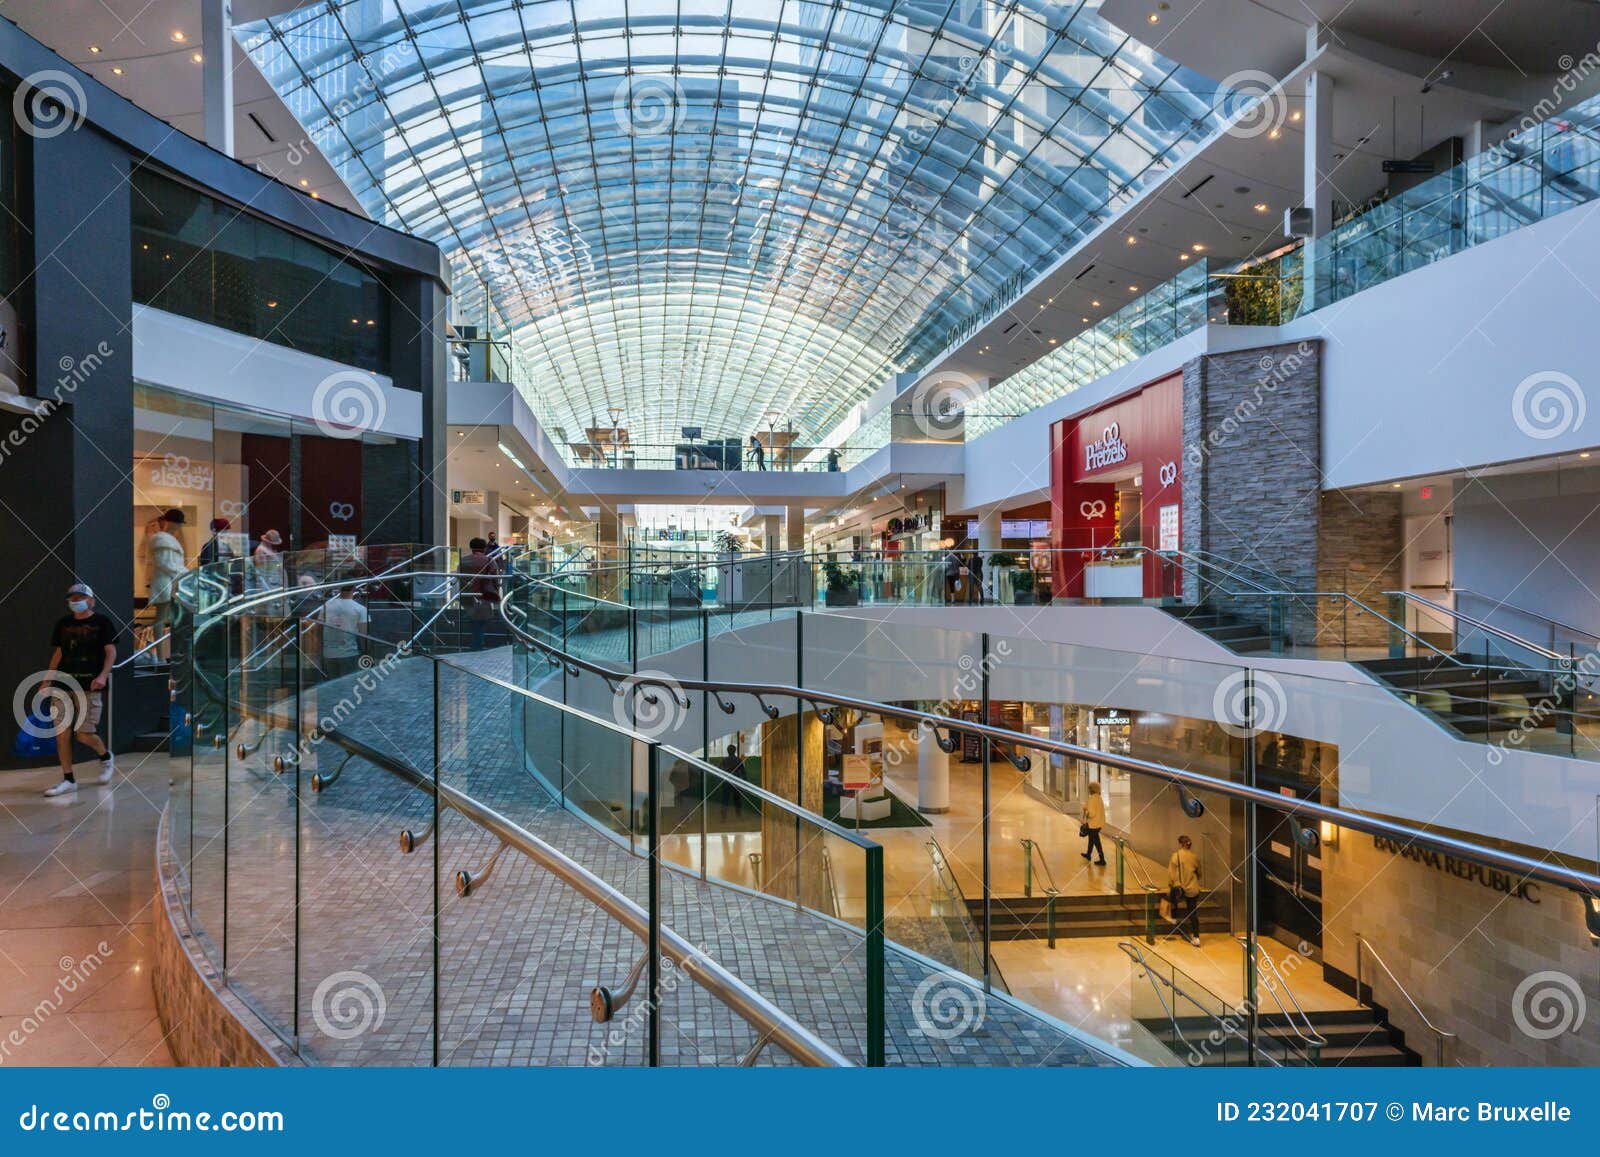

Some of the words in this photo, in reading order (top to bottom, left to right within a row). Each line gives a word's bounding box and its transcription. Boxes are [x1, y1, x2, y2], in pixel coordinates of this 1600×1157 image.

[1085, 438, 1128, 471] Pretzels
[1373, 834, 1443, 871] BANANA
[1444, 854, 1541, 905] REPUBLIC
